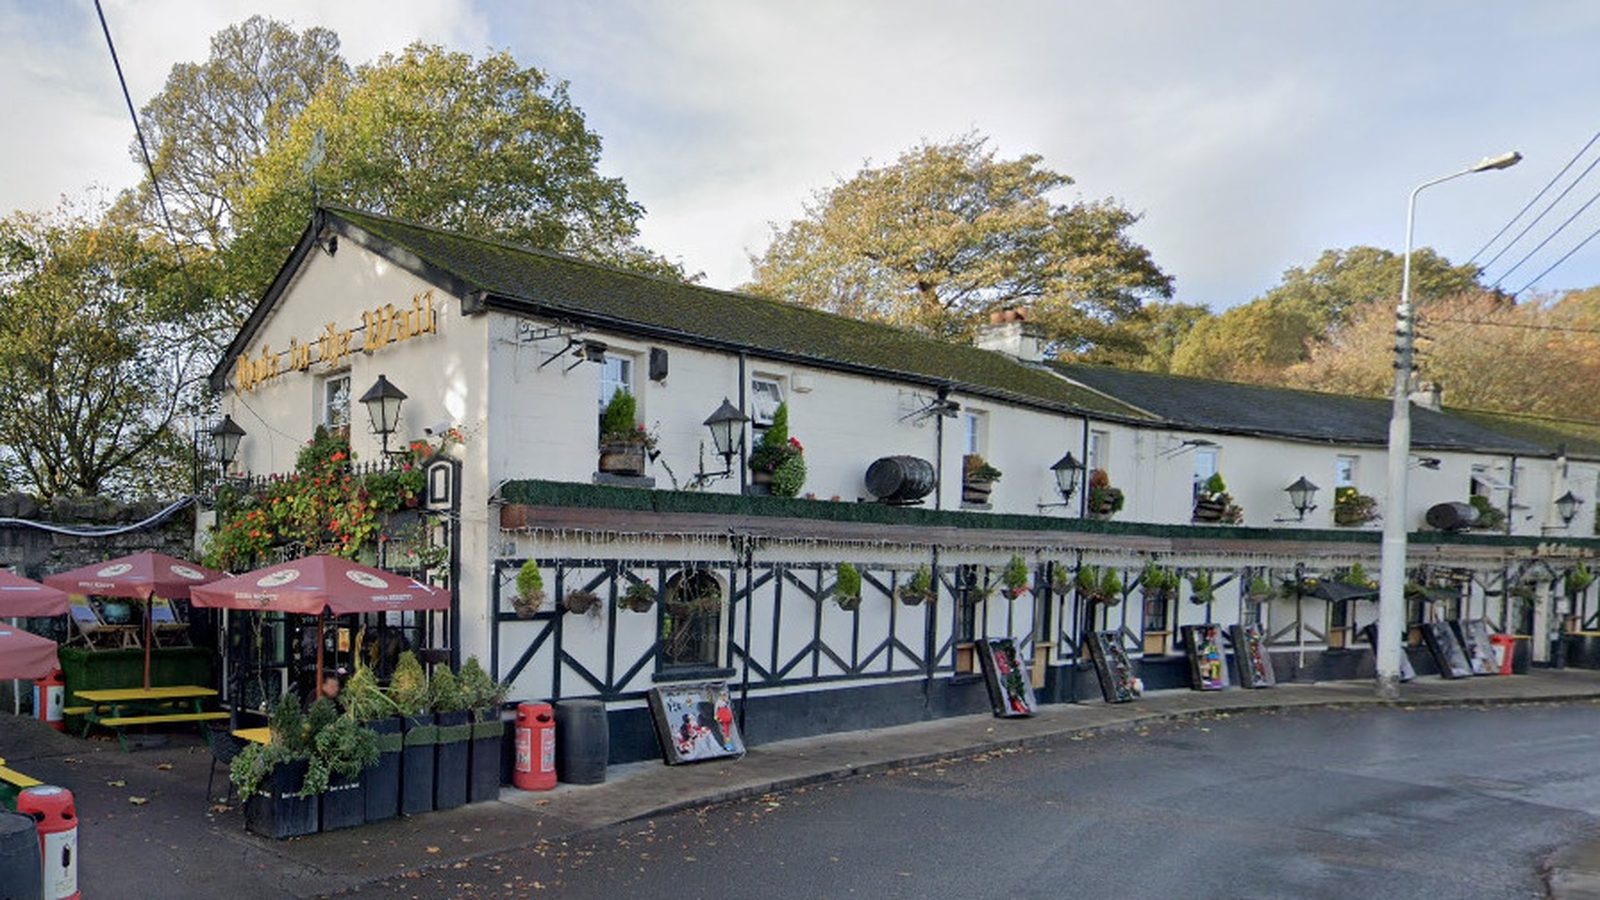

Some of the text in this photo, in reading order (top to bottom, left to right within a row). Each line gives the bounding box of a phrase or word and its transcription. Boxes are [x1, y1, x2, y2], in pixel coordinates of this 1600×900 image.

[291, 335, 309, 371] in
[319, 320, 352, 370] the
[362, 288, 435, 352] Wall
